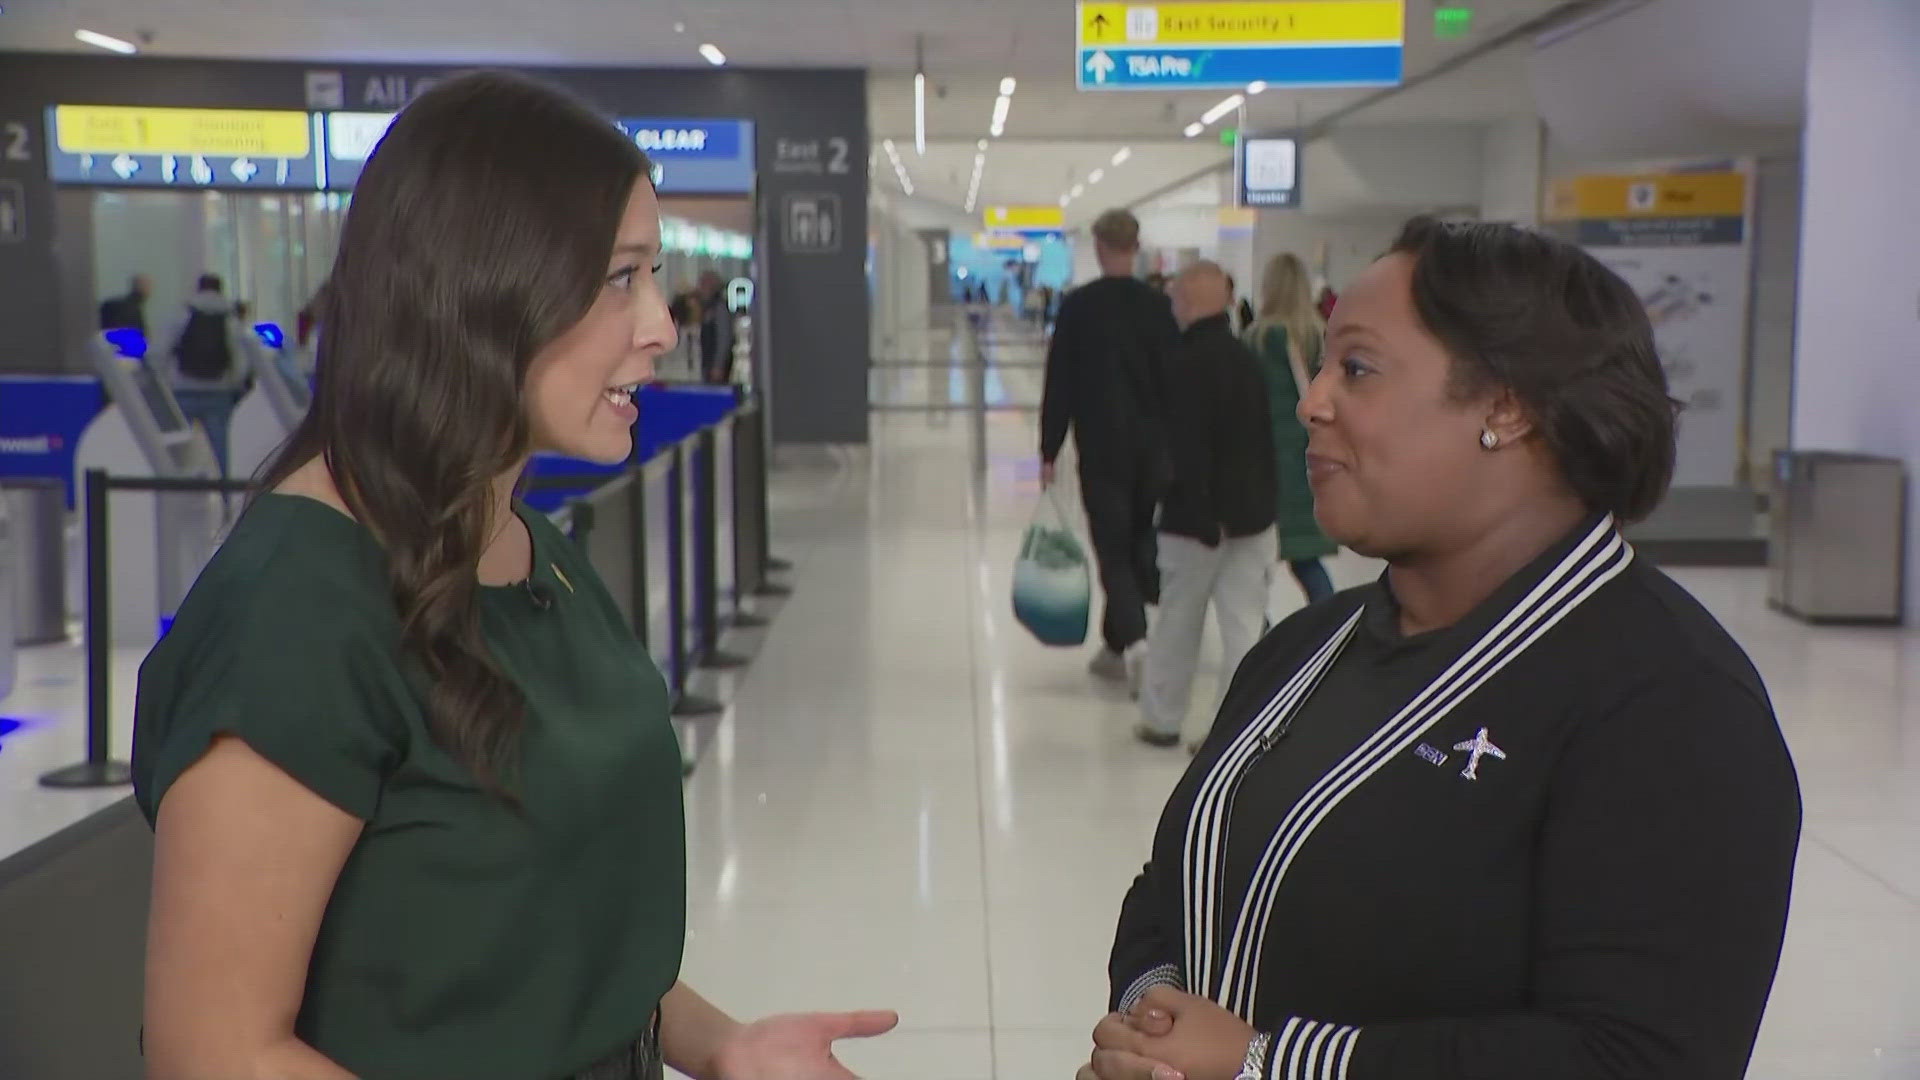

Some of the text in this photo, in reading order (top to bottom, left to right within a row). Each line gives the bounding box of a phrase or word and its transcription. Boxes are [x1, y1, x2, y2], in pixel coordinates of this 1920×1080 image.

[1127, 55, 1160, 77] TSA
[5, 123, 31, 161] 2
[634, 128, 707, 151] CLEAR
[828, 136, 849, 174] 2
